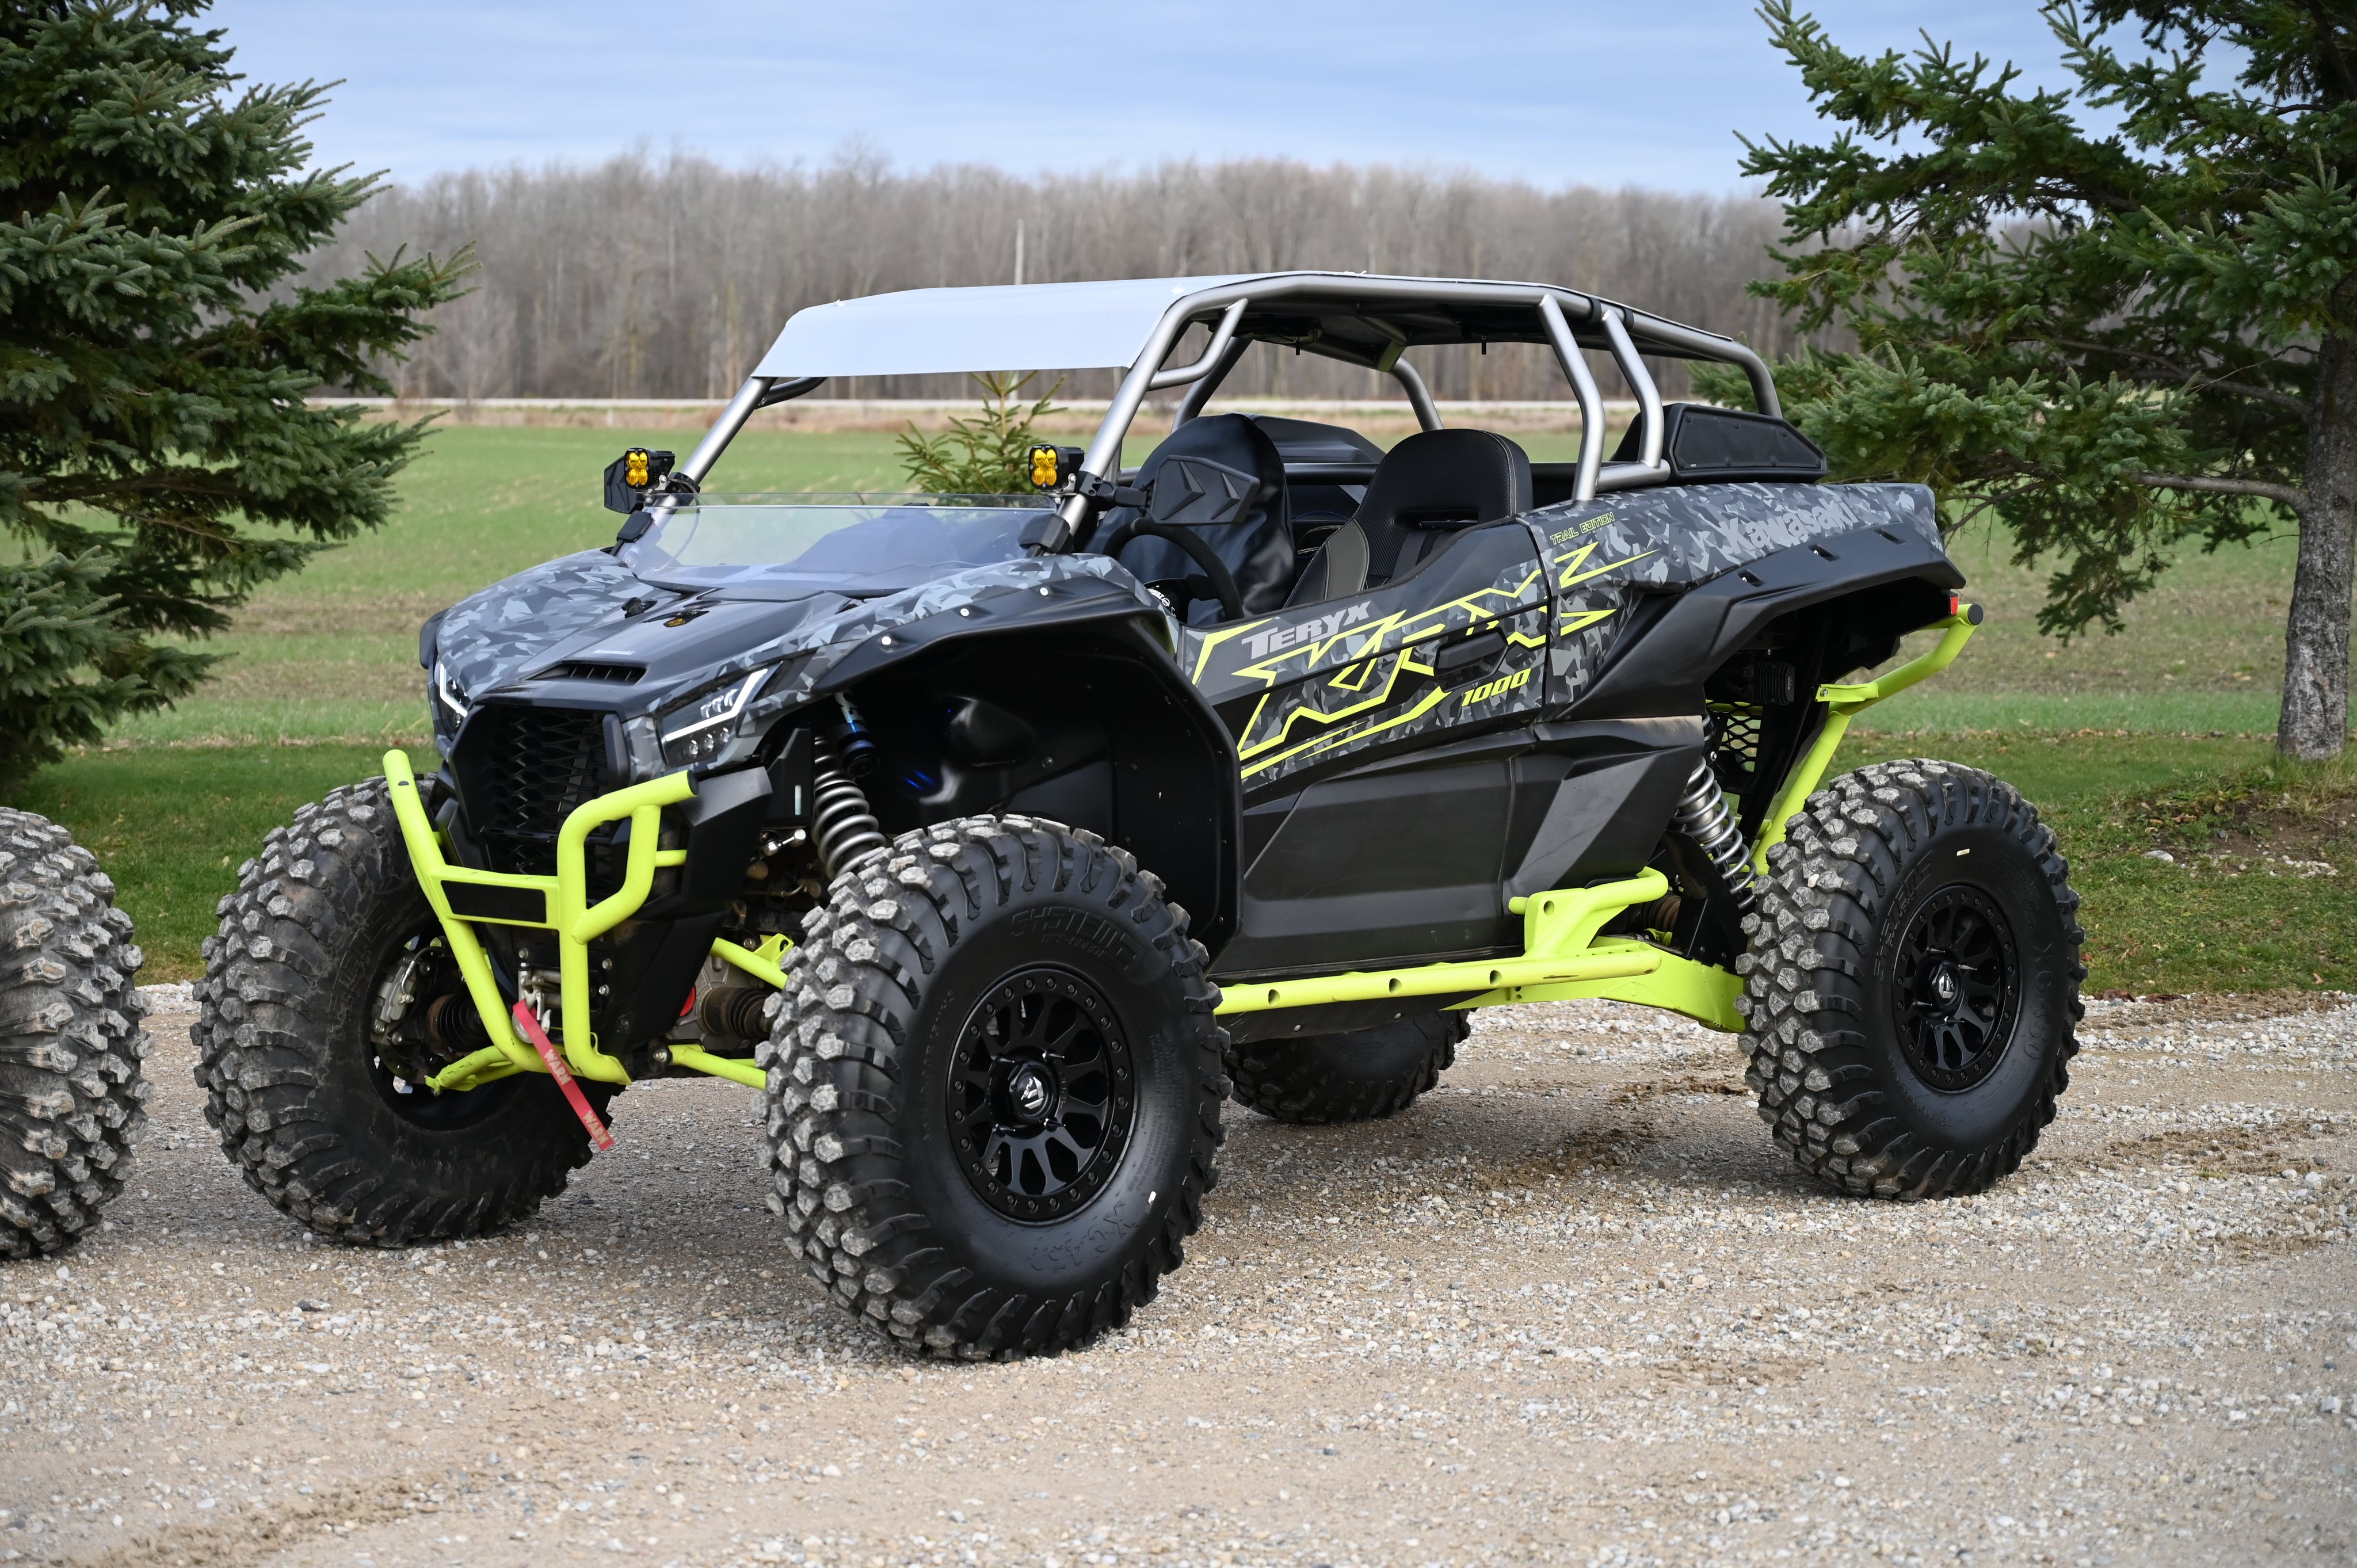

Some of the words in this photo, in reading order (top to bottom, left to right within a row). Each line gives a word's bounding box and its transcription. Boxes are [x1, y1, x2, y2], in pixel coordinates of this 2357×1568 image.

[1550, 527, 1579, 545] TRAIL
[1580, 512, 1615, 534] EDITION
[1719, 498, 1859, 555] Kawasaki
[1461, 667, 1532, 707] 1000
[544, 1048, 571, 1086] WARN
[583, 1110, 609, 1145] WARN
